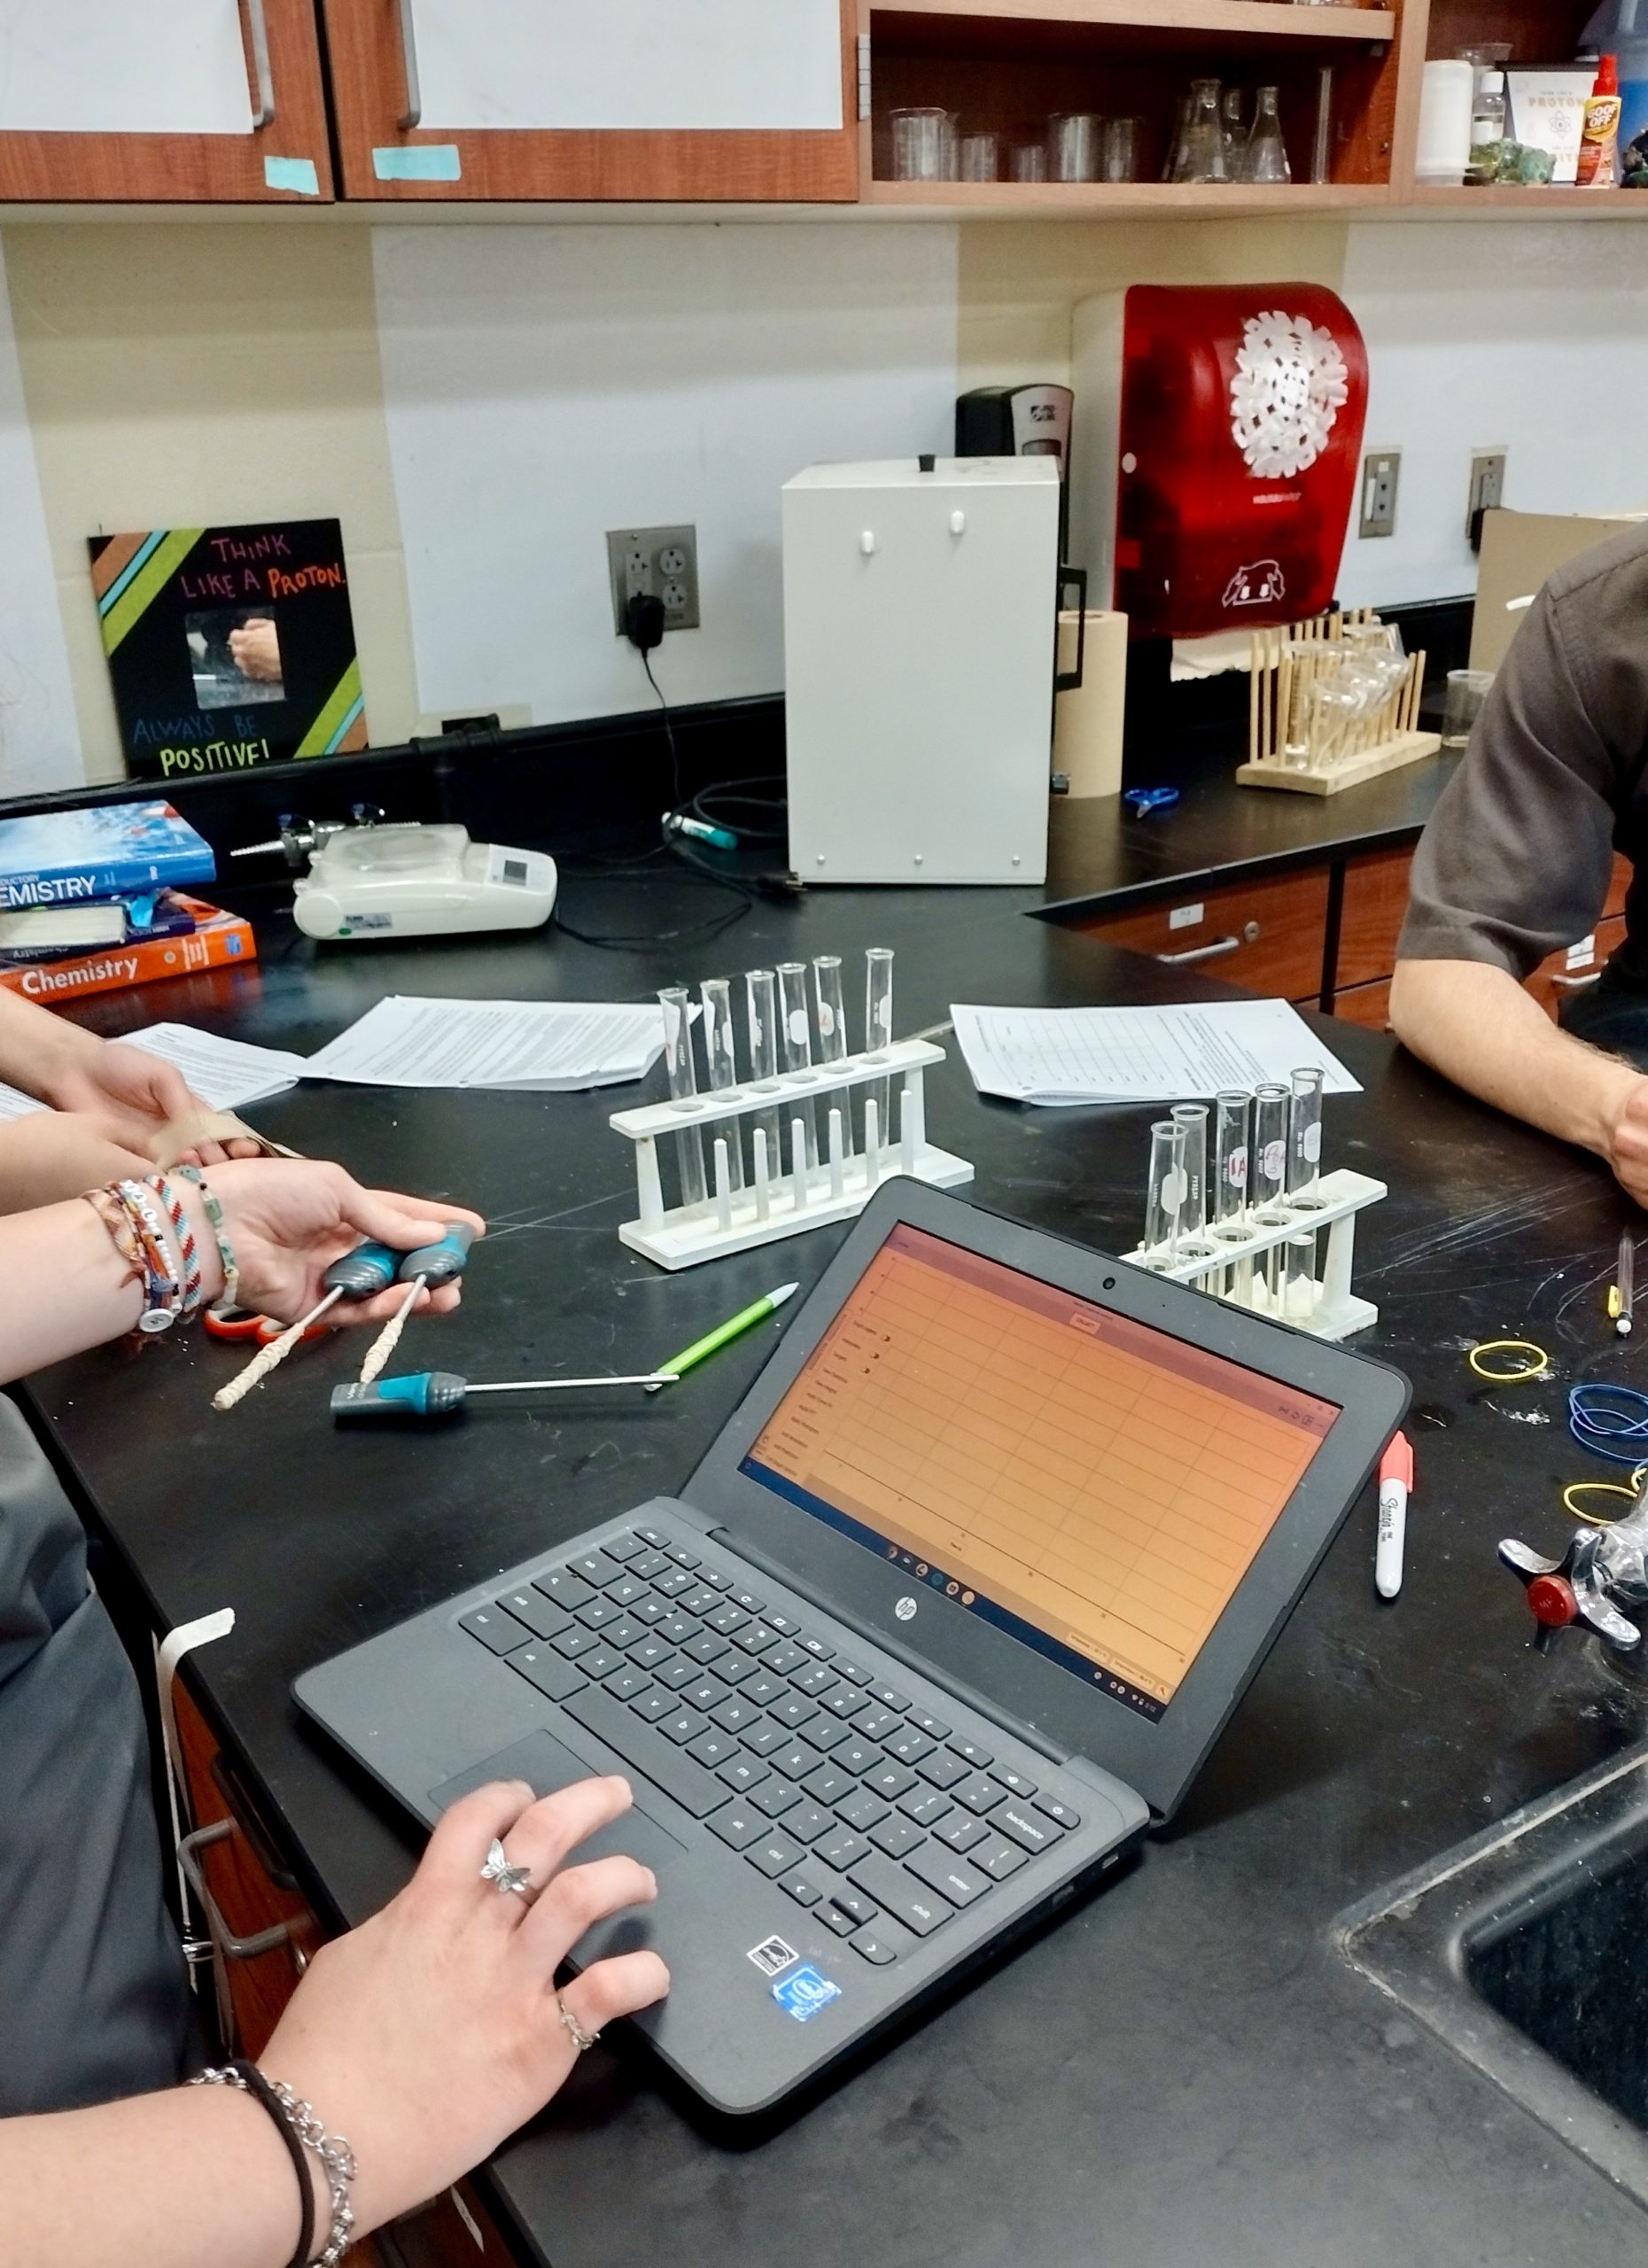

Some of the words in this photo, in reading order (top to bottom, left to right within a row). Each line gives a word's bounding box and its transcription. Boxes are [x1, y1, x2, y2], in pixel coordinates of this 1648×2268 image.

[1587, 104, 1617, 120] GOOF
[1589, 114, 1613, 128] OFF
[210, 534, 292, 563] THINK
[181, 572, 237, 598] LIKE
[244, 568, 261, 591] A
[134, 714, 215, 744] ALWAYS
[233, 714, 257, 738] BE
[22, 958, 138, 994] Chemistry
[896, 1596, 917, 1620] hp
[1006, 1811, 1044, 1840] backspace
